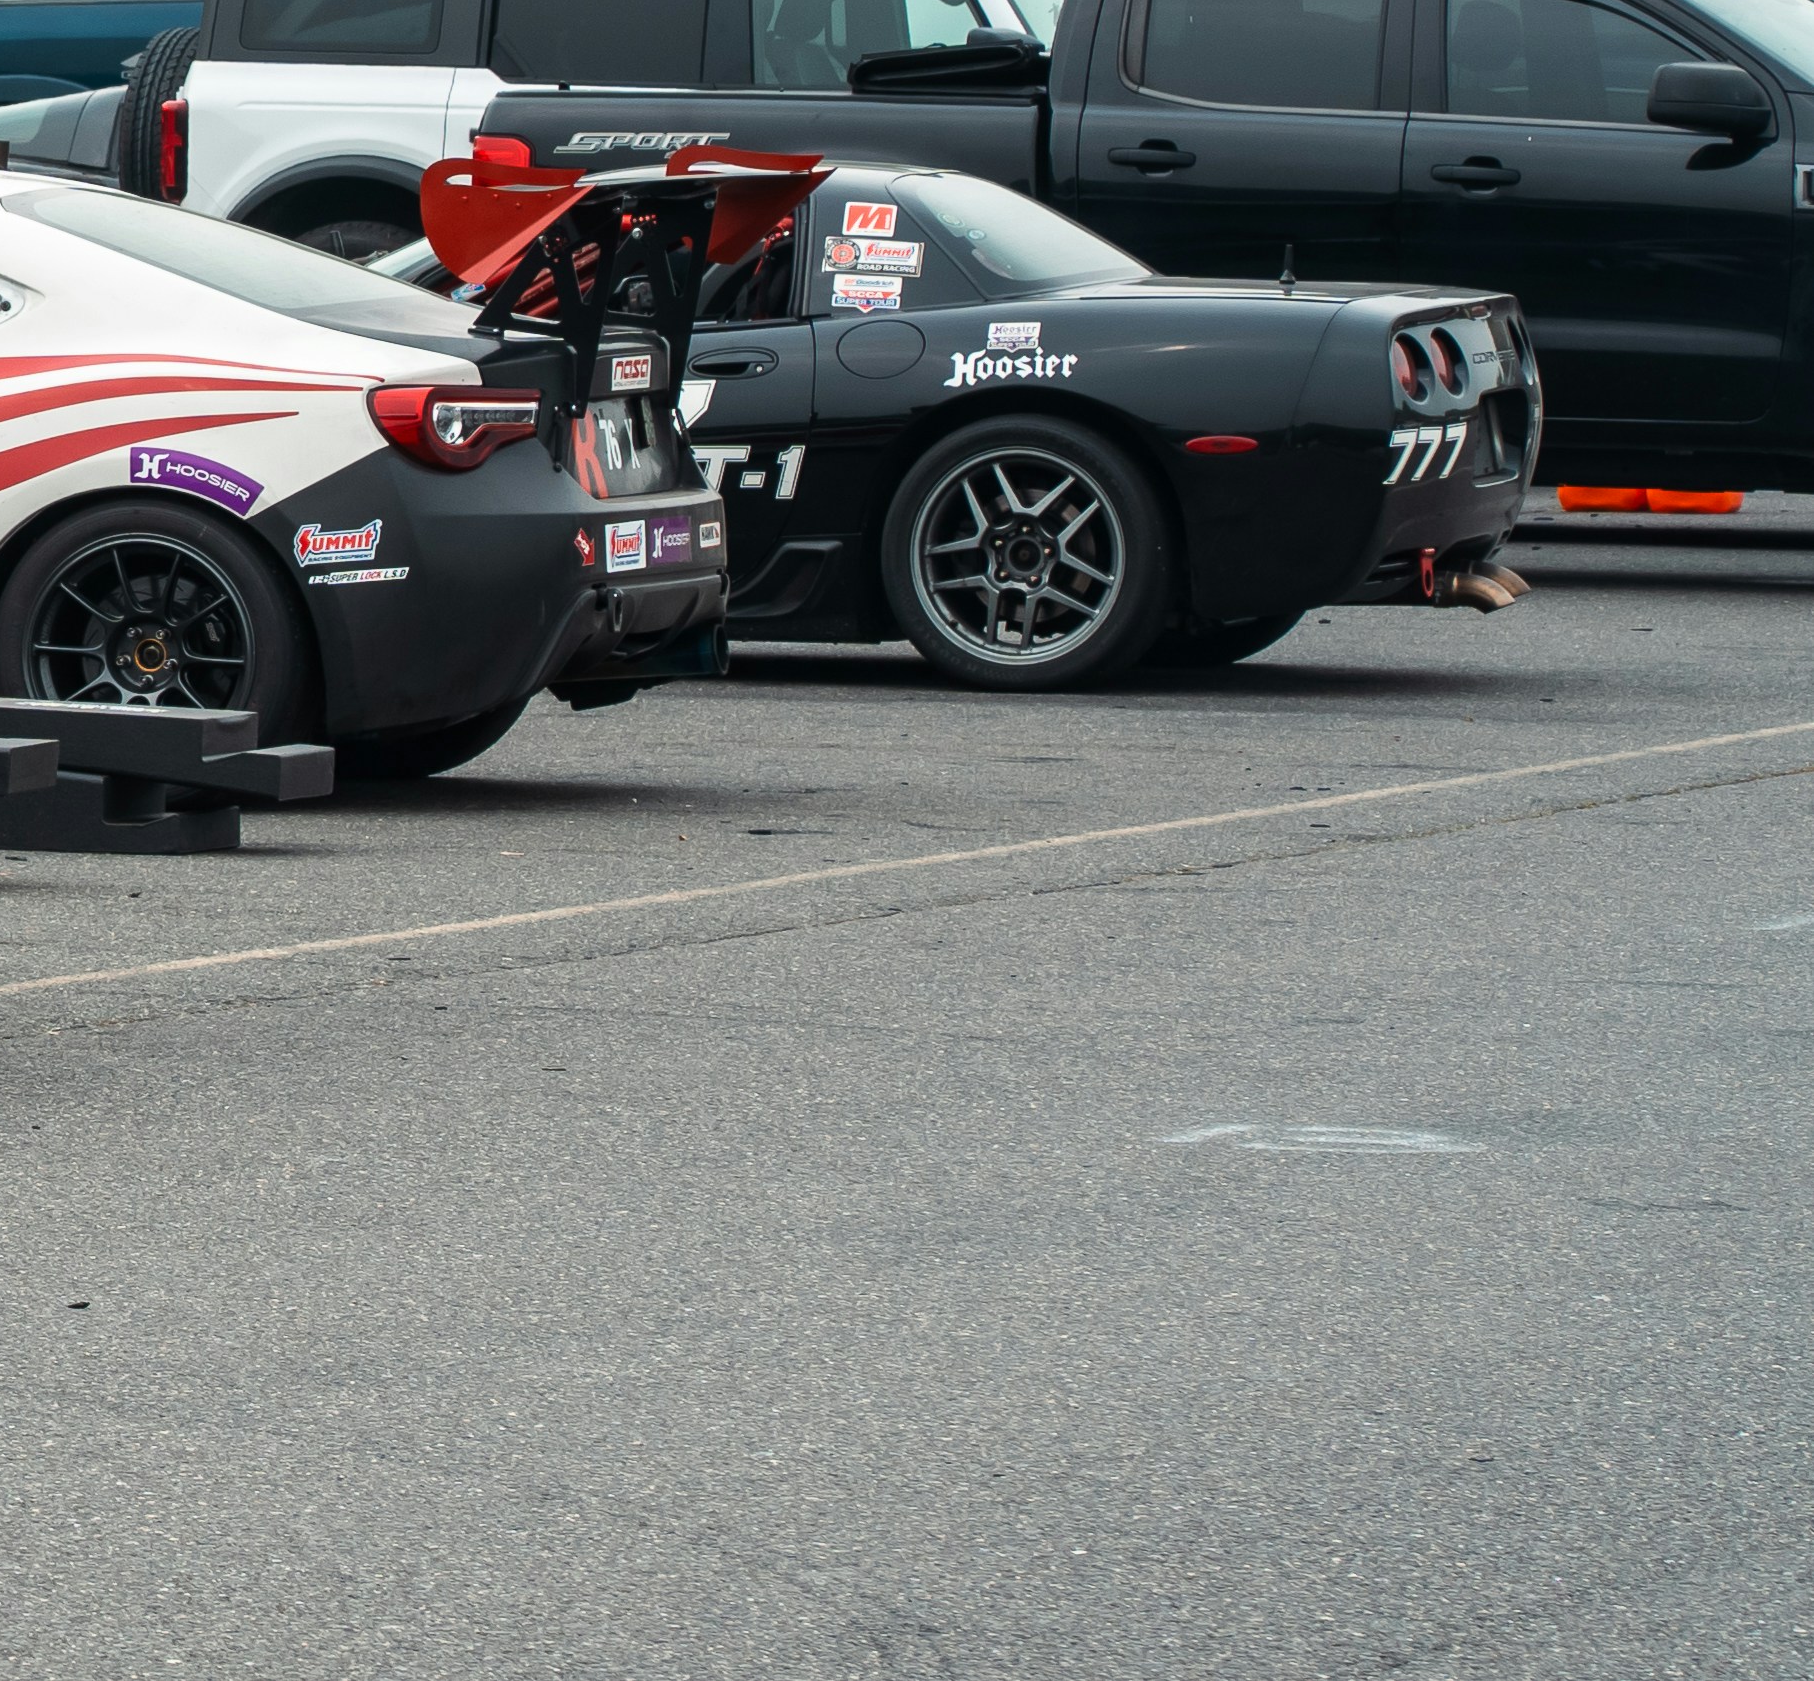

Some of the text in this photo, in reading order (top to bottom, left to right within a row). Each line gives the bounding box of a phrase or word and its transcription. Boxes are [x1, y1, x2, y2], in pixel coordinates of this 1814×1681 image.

[553, 132, 730, 158] SPORT
[856, 263, 916, 273] ROAD RACING
[991, 325, 1037, 334] Hoosier
[943, 346, 1079, 387] Hoosier
[598, 419, 622, 470] 76
[624, 418, 641, 469] X
[1382, 421, 1467, 485] 777
[166, 461, 250, 502] HOOSIER
[330, 572, 359, 582] SUPER
[359, 570, 382, 581] LOCK
